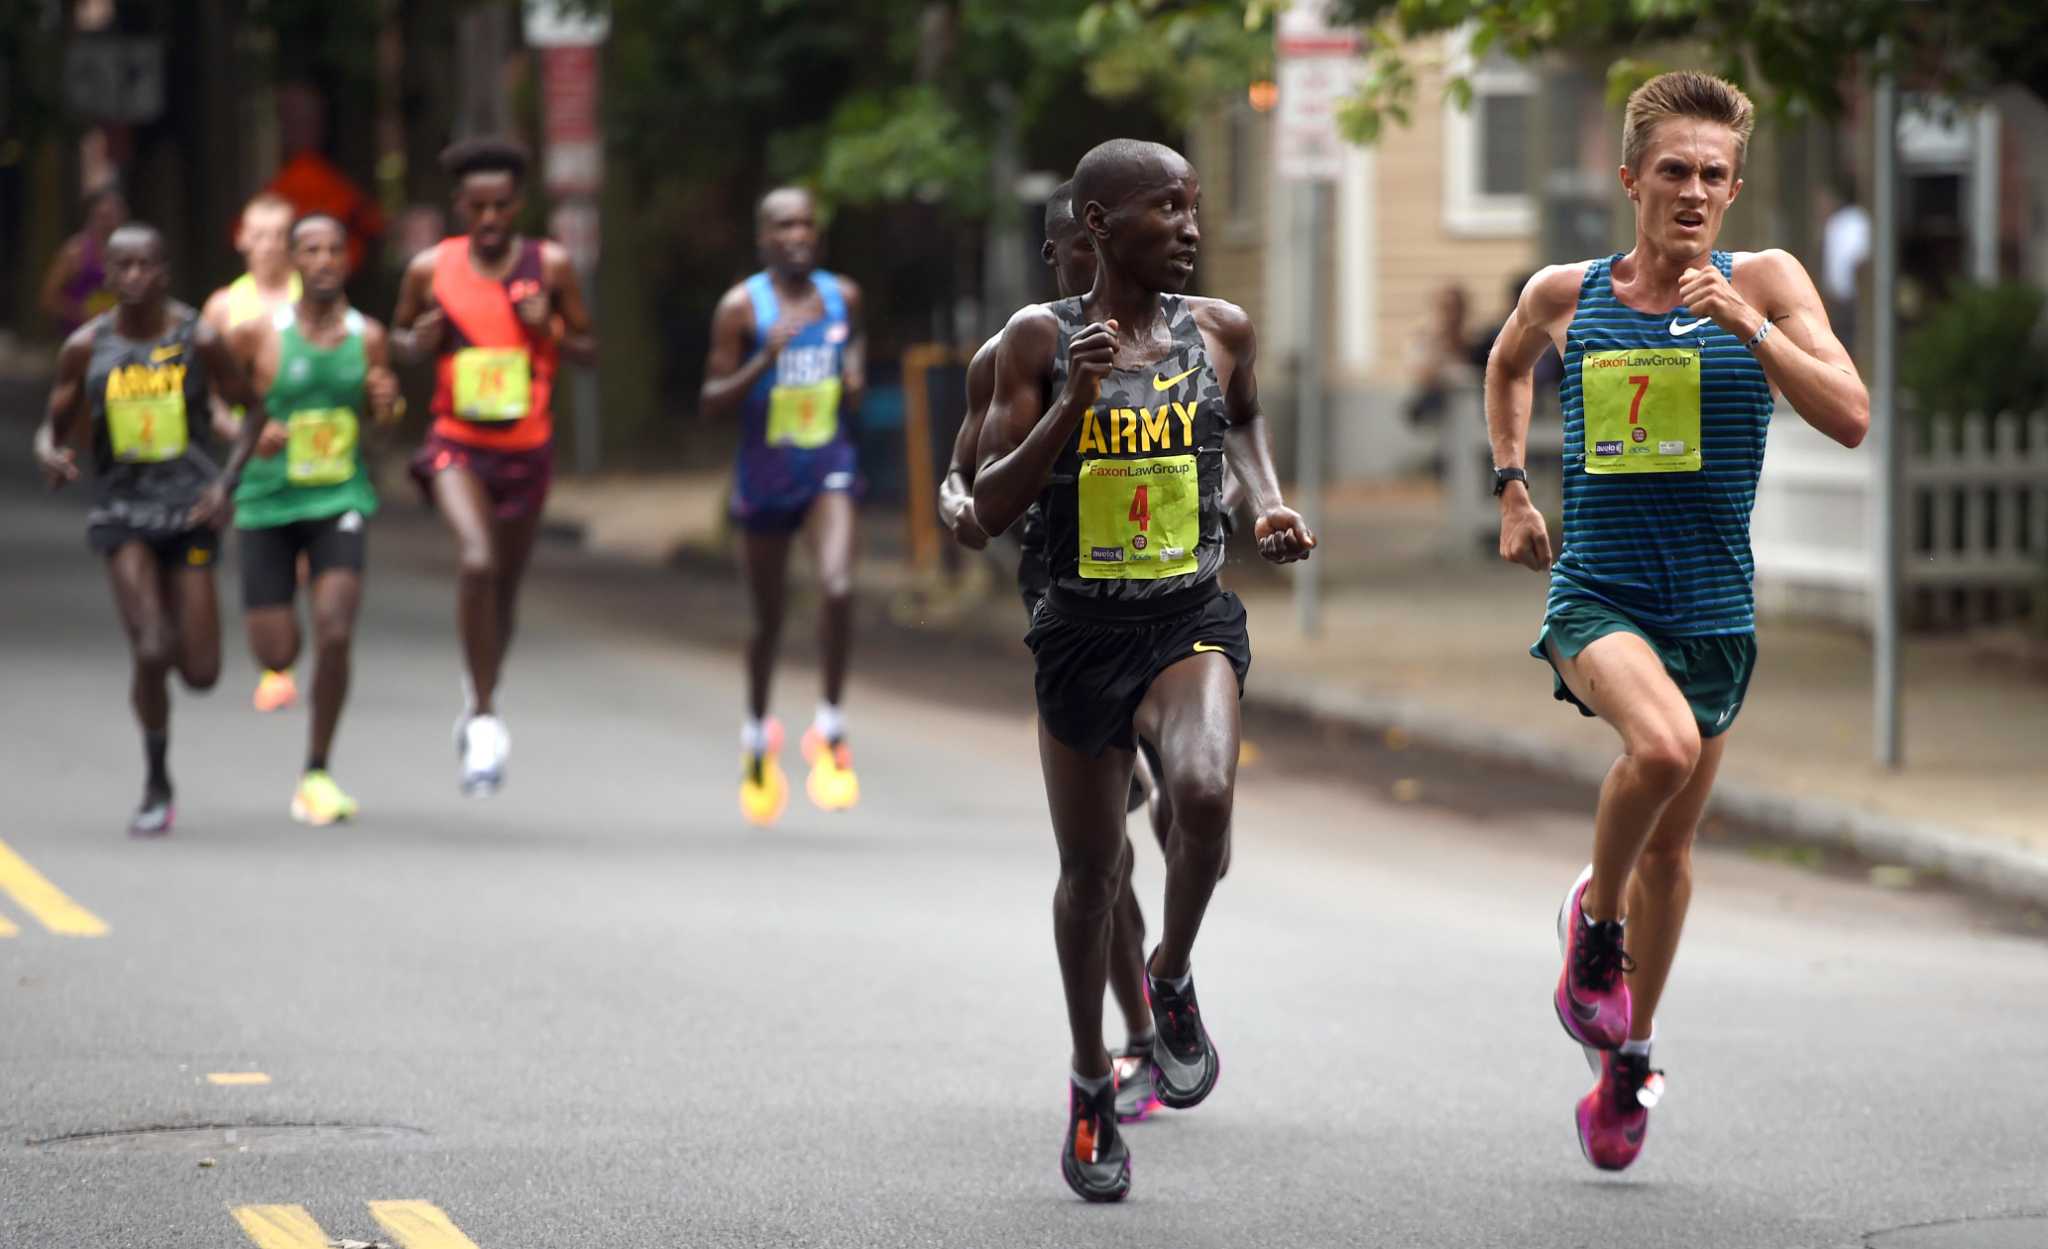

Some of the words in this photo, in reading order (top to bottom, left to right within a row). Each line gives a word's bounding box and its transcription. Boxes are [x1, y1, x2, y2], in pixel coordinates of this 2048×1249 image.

[106, 363, 188, 400] ARMY
[1591, 354, 1692, 368] FaxonLawGroup
[1628, 375, 1650, 425] 7
[1077, 401, 1198, 454] ARMY
[1089, 463, 1190, 478] FaxonLawGroup
[1128, 484, 1152, 532] 4
